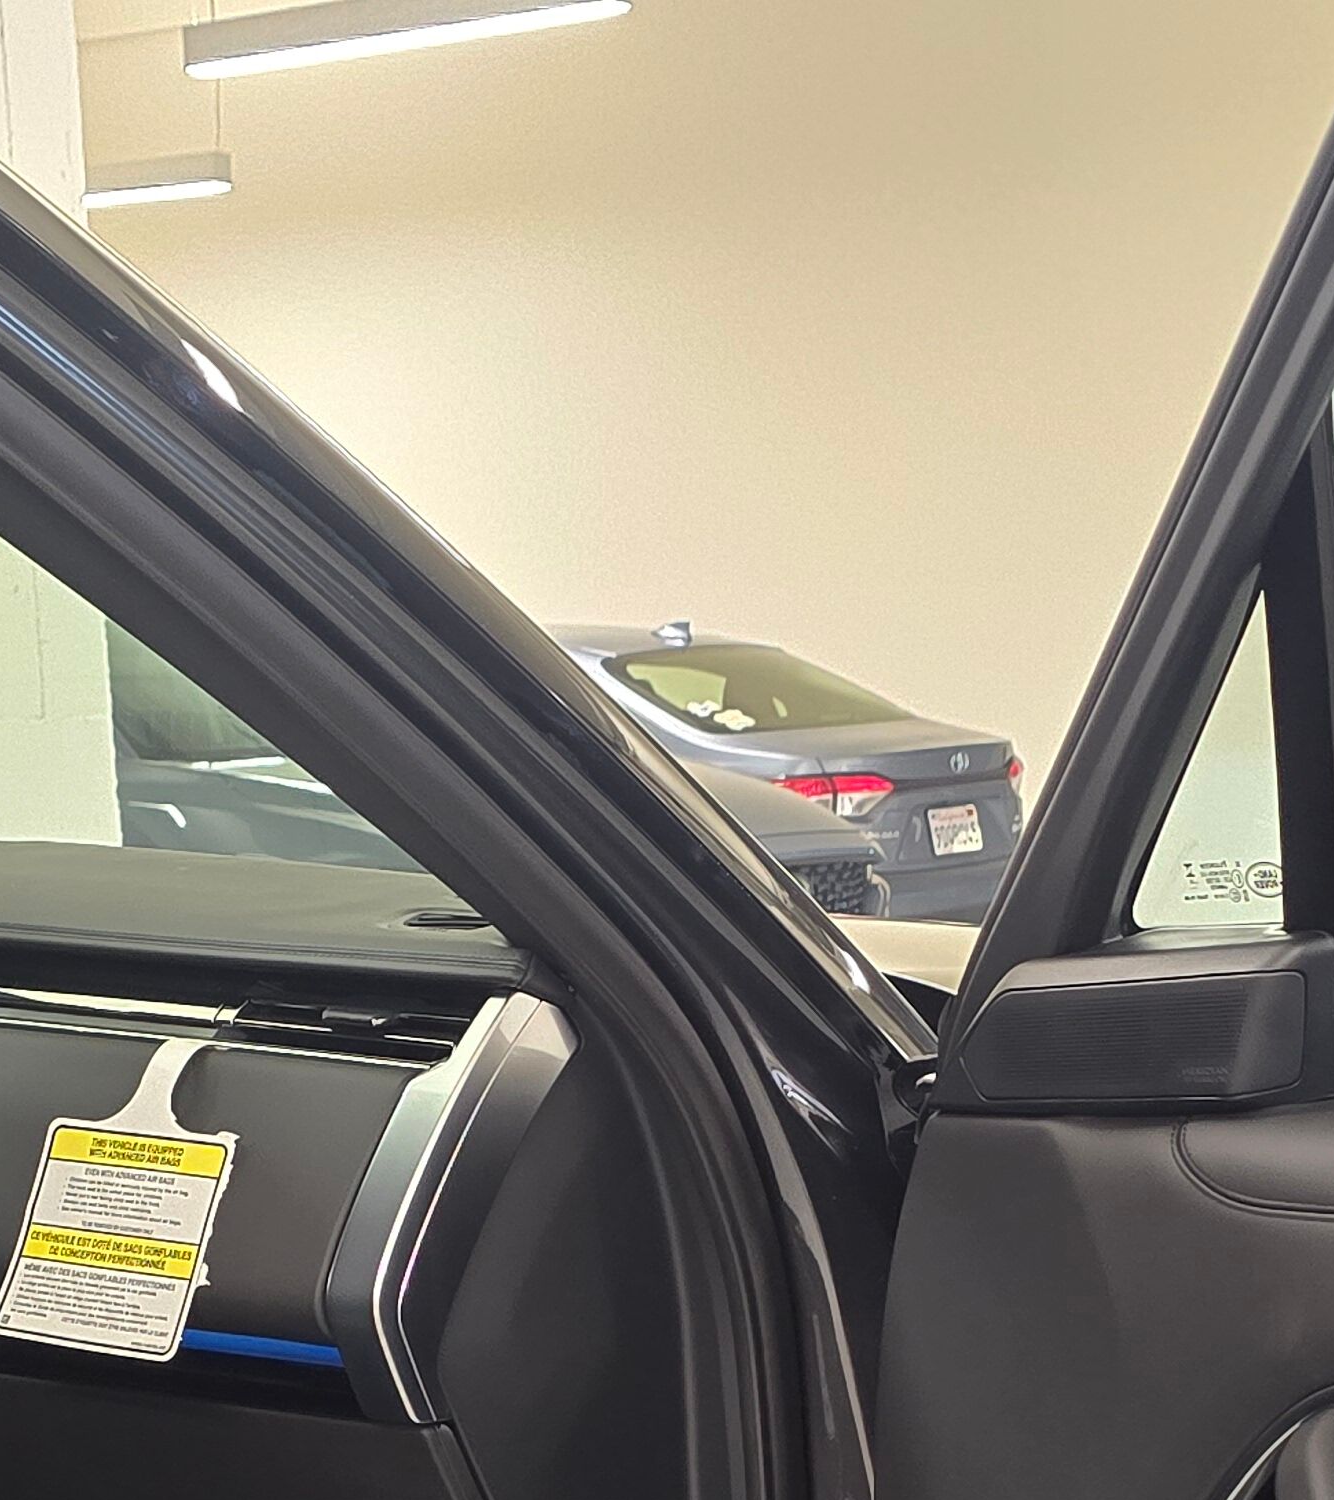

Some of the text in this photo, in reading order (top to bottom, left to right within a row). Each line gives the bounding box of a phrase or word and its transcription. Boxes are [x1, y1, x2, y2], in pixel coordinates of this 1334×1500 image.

[91, 1137, 185, 1157] THIS VEHICLE IS EQUIPPED
[107, 1150, 146, 1163] ADVANCED
[145, 1154, 159, 1164] AIR
[160, 1156, 182, 1167] BAGS
[31, 1229, 41, 1240] CE
[77, 1236, 91, 1247] EST
[112, 1241, 123, 1251] DE
[123, 1242, 144, 1254] SACS
[143, 1245, 192, 1261] GONFLABLES
[48, 1245, 60, 1255] DE
[61, 1247, 107, 1262] CONCEPTION
